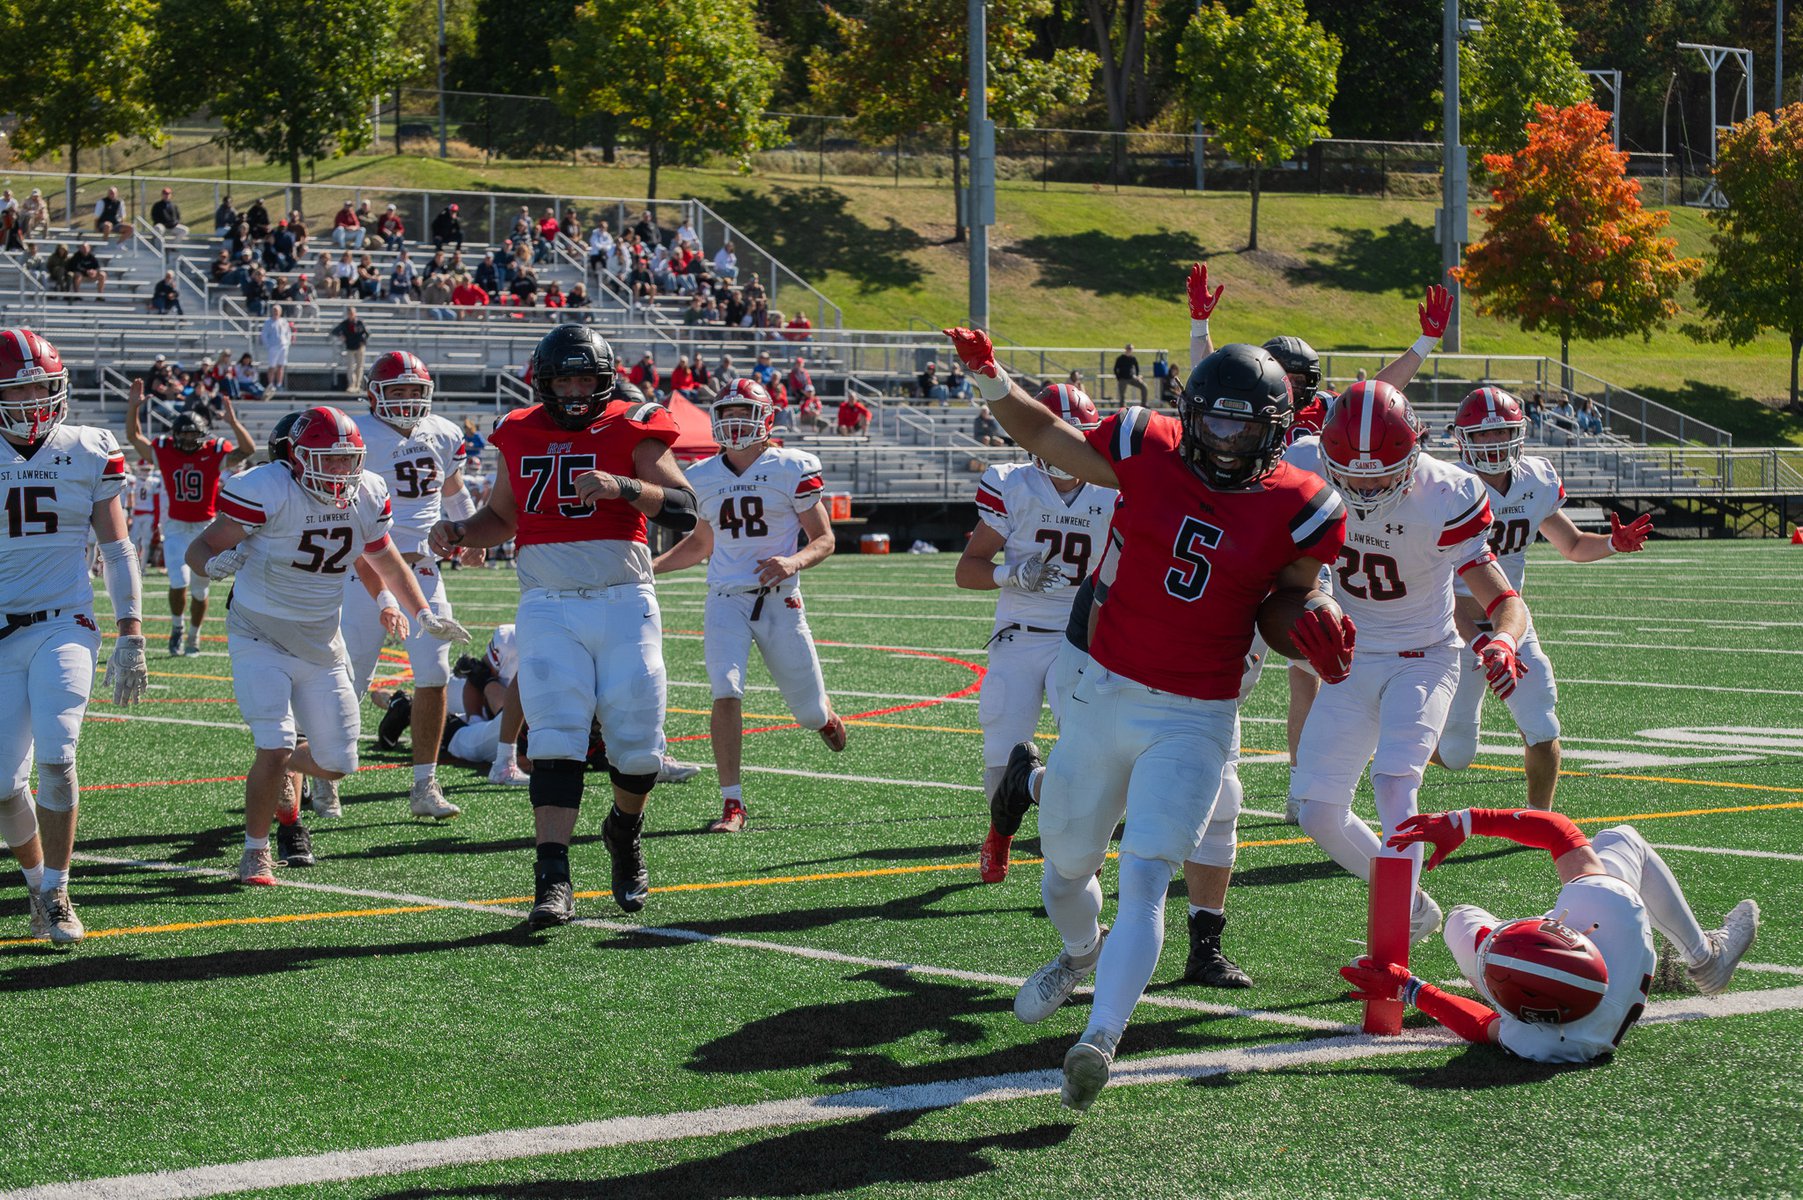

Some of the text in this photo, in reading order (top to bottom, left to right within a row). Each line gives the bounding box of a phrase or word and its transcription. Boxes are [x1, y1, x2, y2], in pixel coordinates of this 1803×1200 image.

[22, 368, 41, 377] SAINTS
[402, 445, 430, 457] LAWRENCE
[546, 442, 573, 454] RPI
[1355, 461, 1377, 469] SAINTS
[1, 471, 58, 481] ST. LAWRENCE
[393, 456, 438, 498] 92
[173, 469, 203, 502] 19
[520, 453, 597, 518] 75
[729, 484, 758, 493] LAWRENCE
[4, 486, 58, 538] 15
[305, 512, 350, 524] ST. LAWRENCE
[719, 495, 768, 539] 48
[1498, 505, 1526, 515] LAWRENCE
[1041, 514, 1091, 528] ST. LAWRENCE
[1348, 531, 1391, 549] LAWRENCE
[291, 526, 353, 574] 52
[1035, 528, 1091, 586] 29
[1164, 515, 1224, 602] 5
[1336, 545, 1407, 601] 20
